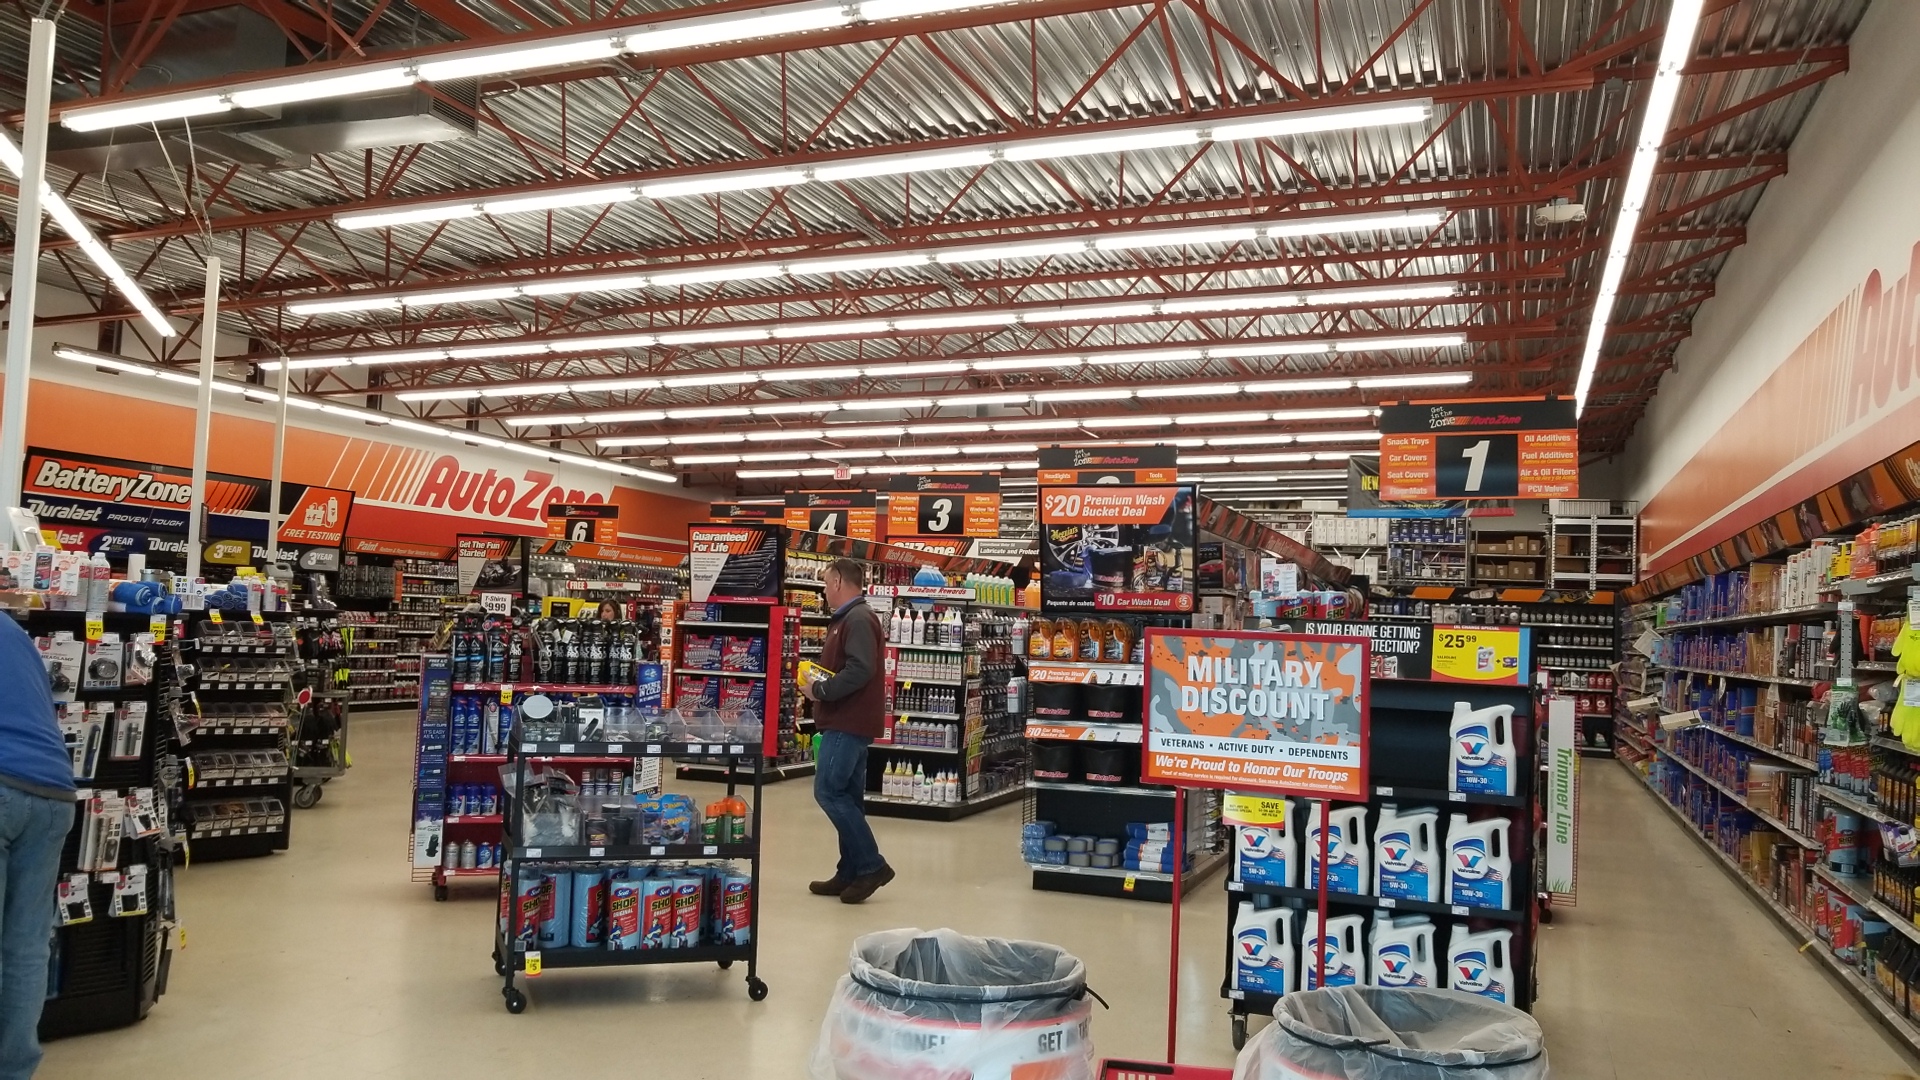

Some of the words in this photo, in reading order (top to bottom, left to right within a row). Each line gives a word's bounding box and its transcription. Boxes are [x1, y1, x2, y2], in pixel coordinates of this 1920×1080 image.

[1846, 240, 1920, 425] Aut
[1429, 416, 1456, 429] Zone
[1387, 438, 1409, 446] Snack
[1410, 437, 1430, 446] Trays
[1524, 434, 1535, 443] Oil
[1536, 434, 1571, 442] Additives
[1389, 454, 1402, 462] Car
[1403, 454, 1428, 462] Covers
[1540, 451, 1573, 459] Additives
[1462, 440, 1490, 492] 1
[1520, 469, 1531, 477] Air
[1540, 468, 1551, 476] Oil
[1552, 468, 1576, 476] Filters
[34, 460, 192, 503] BatteryZone
[1387, 471, 1403, 479] Seat
[1404, 471, 1429, 479] Covers
[1361, 475, 1379, 490] NEW
[1528, 485, 1542, 493] PCV
[1044, 494, 1080, 517] $20
[1084, 494, 1133, 506] Premium
[1135, 494, 1166, 505] Wash
[1082, 506, 1119, 517] Bucket
[1122, 506, 1147, 517] Deal
[27, 499, 102, 522] Duralast
[107, 513, 149, 524] PROVEN
[152, 518, 184, 528] TOUGH
[928, 498, 953, 532] 3
[818, 513, 838, 535] 4
[56, 530, 84, 545] last
[283, 528, 306, 539] FREE
[307, 530, 342, 542] TESTING
[571, 521, 588, 542] 6
[692, 531, 749, 542] Guaranteed
[99, 535, 113, 551] 2
[112, 536, 135, 546] YEAR
[147, 537, 188, 553] Durala
[357, 541, 378, 552] Paint
[458, 540, 471, 550] Get
[472, 541, 486, 550] The
[486, 541, 501, 550] Fun
[692, 542, 708, 552] For
[711, 542, 730, 553] Life
[213, 543, 225, 559] 3
[224, 545, 243, 554] YEAR
[251, 545, 299, 561] Dulast
[458, 549, 487, 558] Started
[980, 547, 1004, 555] Lubricate
[307, 552, 317, 566] 3
[316, 553, 333, 561] YEAR
[570, 581, 585, 590] FREE
[873, 586, 894, 596] FREE
[907, 586, 937, 594] AutoZone
[938, 587, 967, 595] Rewards
[1046, 599, 1069, 608] Paquete
[1076, 599, 1096, 607] cubeta
[1097, 593, 1115, 606] $10
[1117, 598, 1130, 606] Car
[1131, 598, 1152, 606] Wash
[1153, 598, 1170, 606] Deal
[1326, 607, 1346, 619] SHO
[1305, 622, 1315, 634] IS
[1317, 622, 1341, 636] YOUR
[1344, 624, 1378, 637] ENGINE
[1380, 625, 1421, 640] GETTING
[1371, 639, 1420, 654] TECTION?
[1187, 655, 1323, 688] MILITARY
[1181, 685, 1329, 721] DISCOUNT
[1161, 738, 1205, 749] VETERANS
[1218, 742, 1249, 752] ACTIVE
[1251, 745, 1274, 754] DUTY
[1288, 747, 1349, 760] DEPENDENTS
[1155, 754, 1188, 769] We're
[1190, 757, 1226, 772] Proud
[1228, 762, 1240, 773] to
[1243, 761, 1280, 776] Honor
[1282, 764, 1305, 778] Our
[1307, 766, 1349, 783] Troops
[1465, 776, 1488, 784] 10W-30
[1556, 748, 1572, 810] Trimmer
[1261, 801, 1280, 810] SAVE
[1556, 812, 1571, 845] Line
[1457, 867, 1481, 875] Valvoline
[617, 889, 630, 897] Scott
[1389, 882, 1408, 890] 5W-30
[725, 892, 748, 906] SHOP
[1461, 889, 1484, 898] 10W-30
[522, 897, 540, 912] SHO
[611, 897, 636, 911] SHOP
[651, 897, 672, 911] SHO
[675, 893, 700, 909] SHOP
[613, 908, 634, 918] ORIGINAL
[1038, 1030, 1063, 1054] GET
